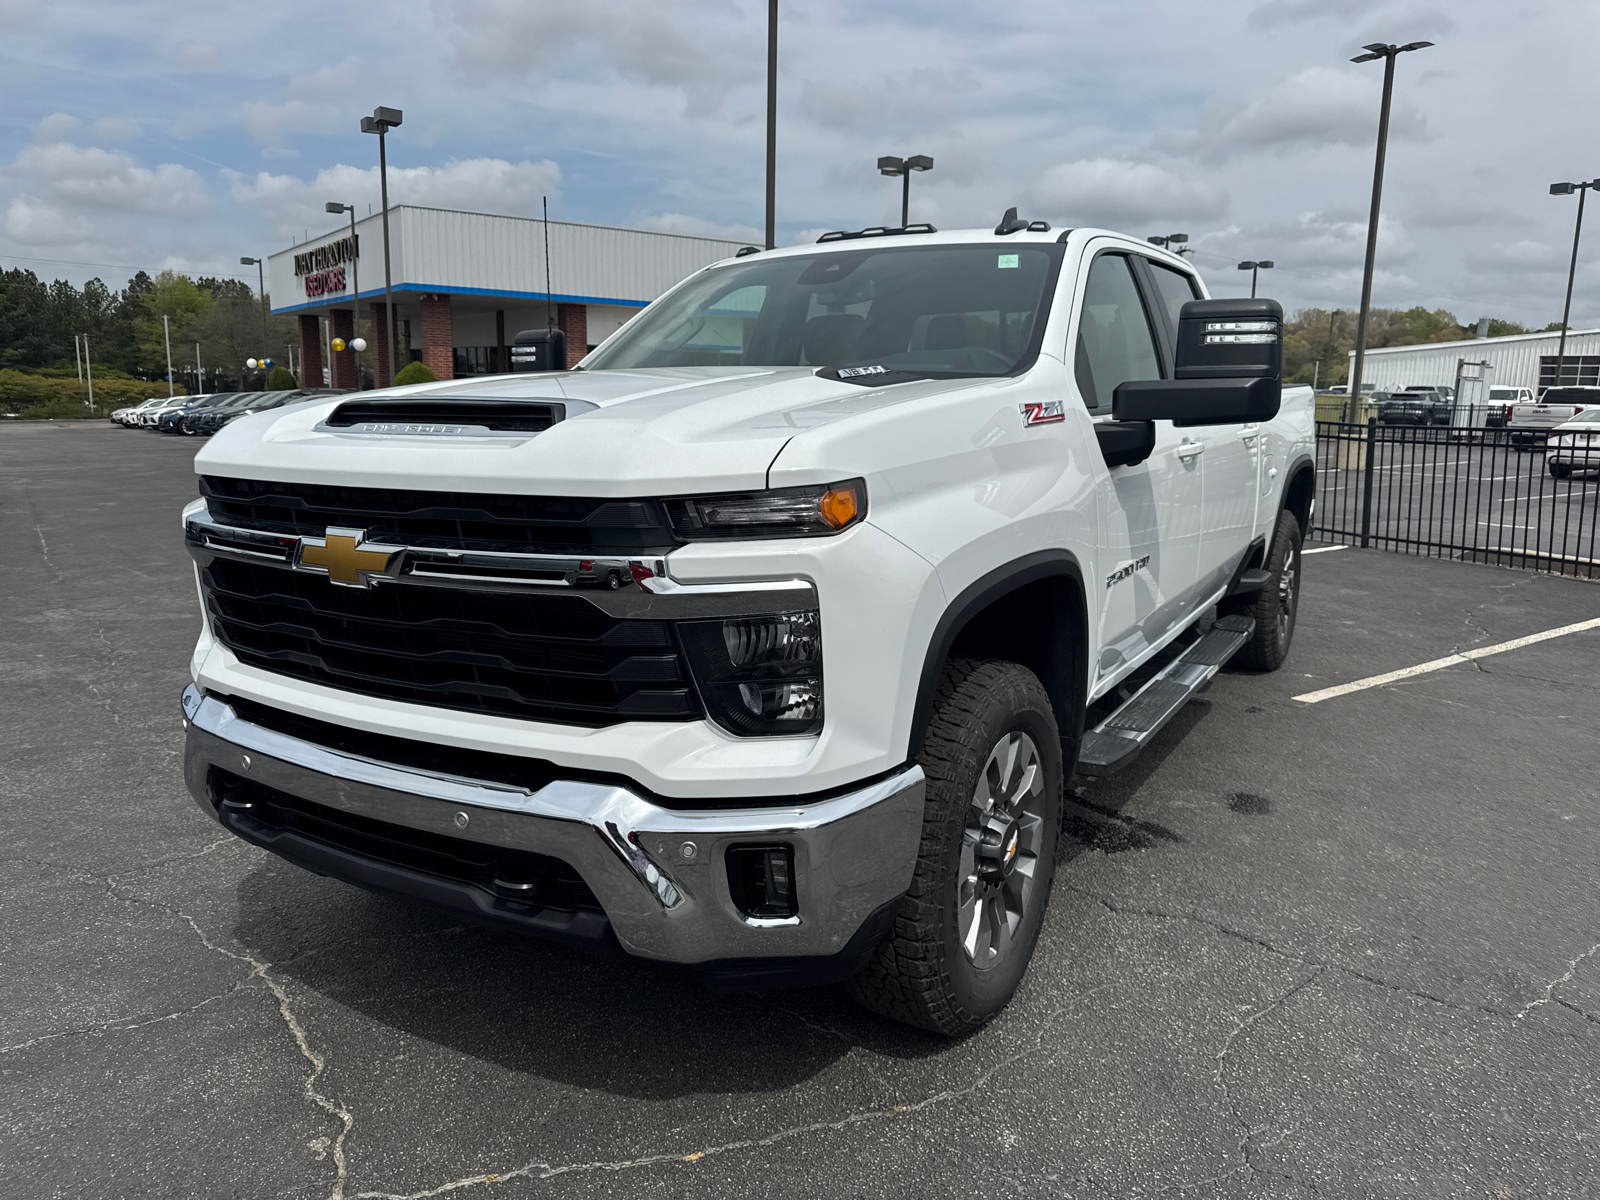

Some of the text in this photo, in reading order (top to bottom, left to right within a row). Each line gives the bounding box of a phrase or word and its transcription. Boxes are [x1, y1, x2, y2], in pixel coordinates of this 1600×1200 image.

[294, 250, 313, 276] JOHN
[305, 267, 346, 297] USED CARS
[1019, 400, 1066, 428] Z71
